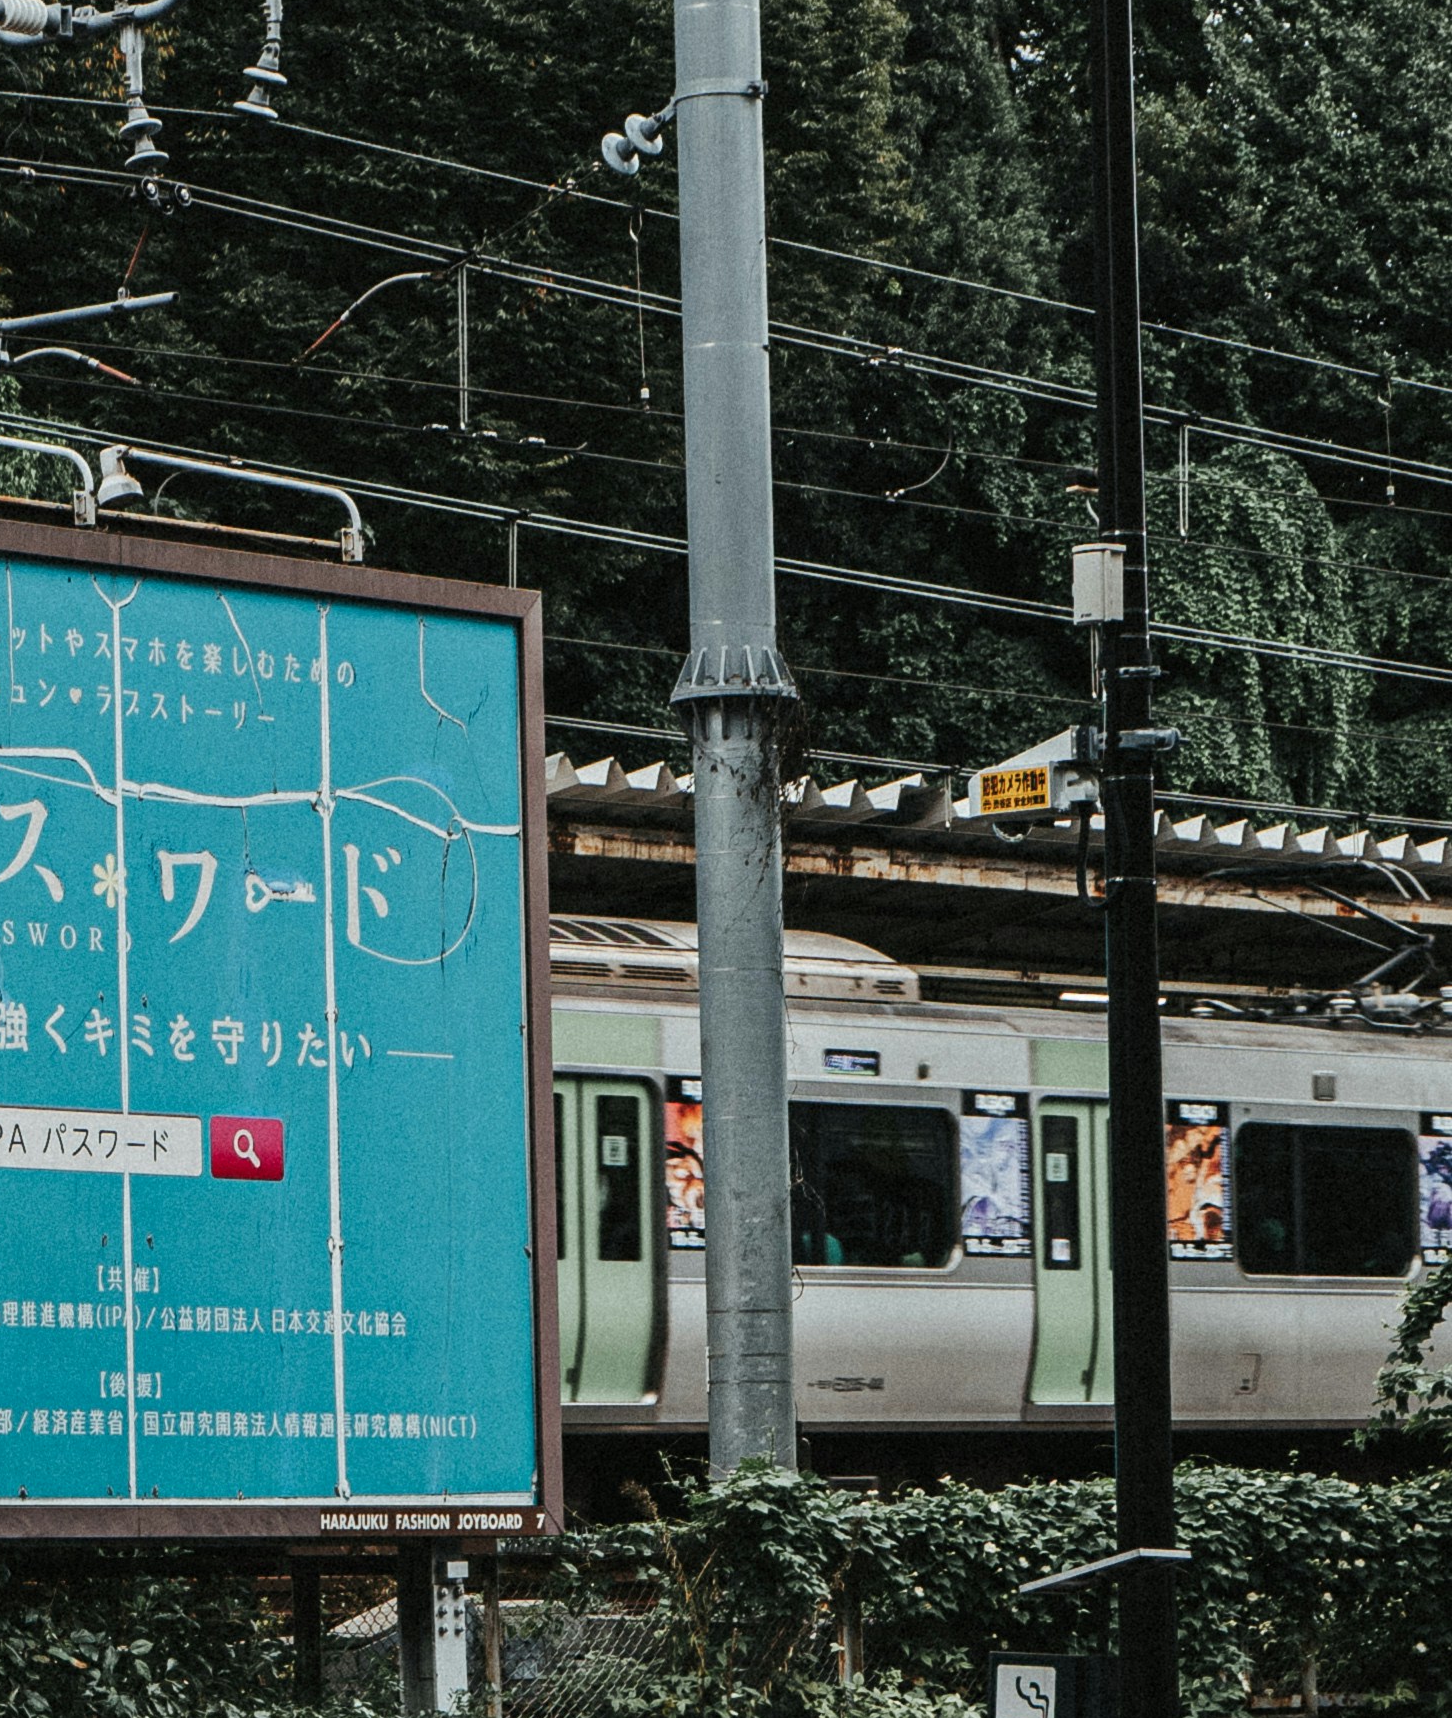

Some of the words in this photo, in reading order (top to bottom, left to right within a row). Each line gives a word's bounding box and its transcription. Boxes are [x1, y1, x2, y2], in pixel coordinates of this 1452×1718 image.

[42, 1122, 169, 1162] パスワード
[320, 1513, 389, 1530] HARAJUKU
[395, 1513, 450, 1530] FASHION
[456, 1513, 523, 1530] JOYBOARD
[536, 1514, 546, 1529] 7
